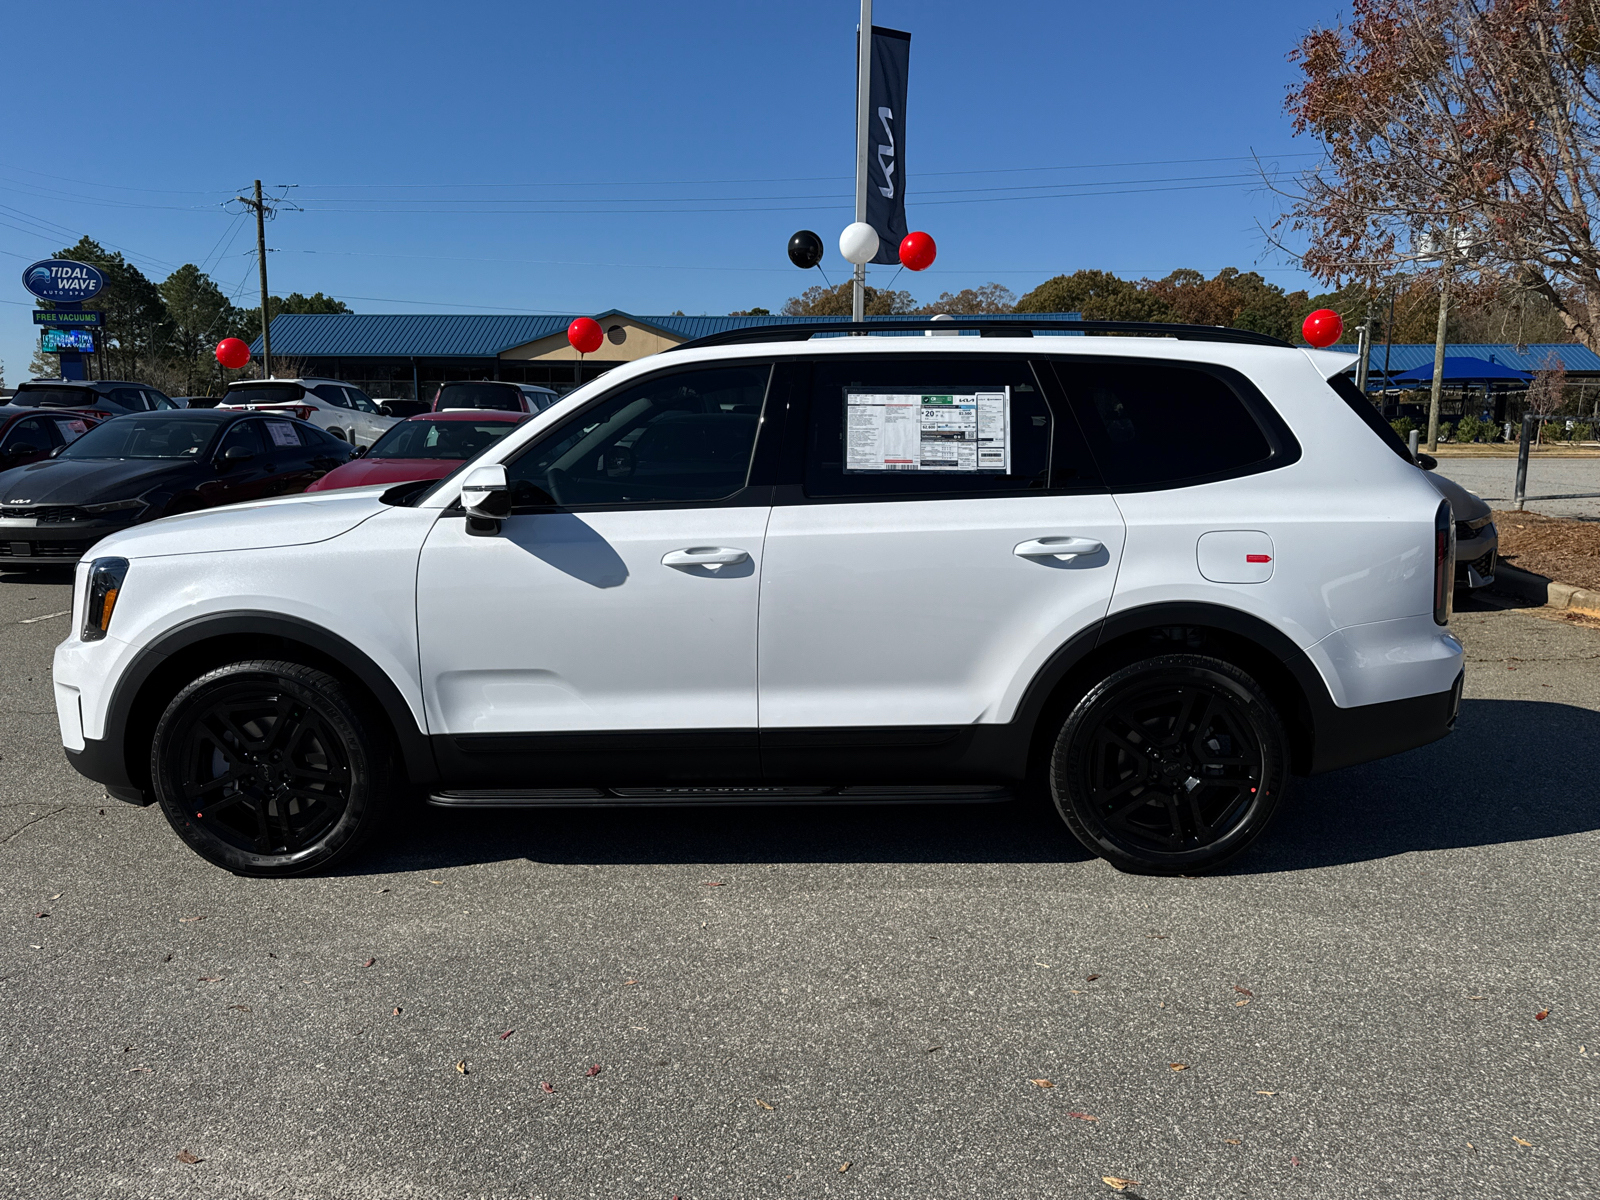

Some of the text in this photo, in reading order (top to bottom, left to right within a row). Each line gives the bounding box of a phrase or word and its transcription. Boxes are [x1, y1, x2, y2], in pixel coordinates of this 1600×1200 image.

[878, 106, 895, 199] KIA
[51, 267, 88, 278] TIDAL
[58, 279, 96, 290] WAVE
[36, 313, 96, 322] FREE VACUUMS
